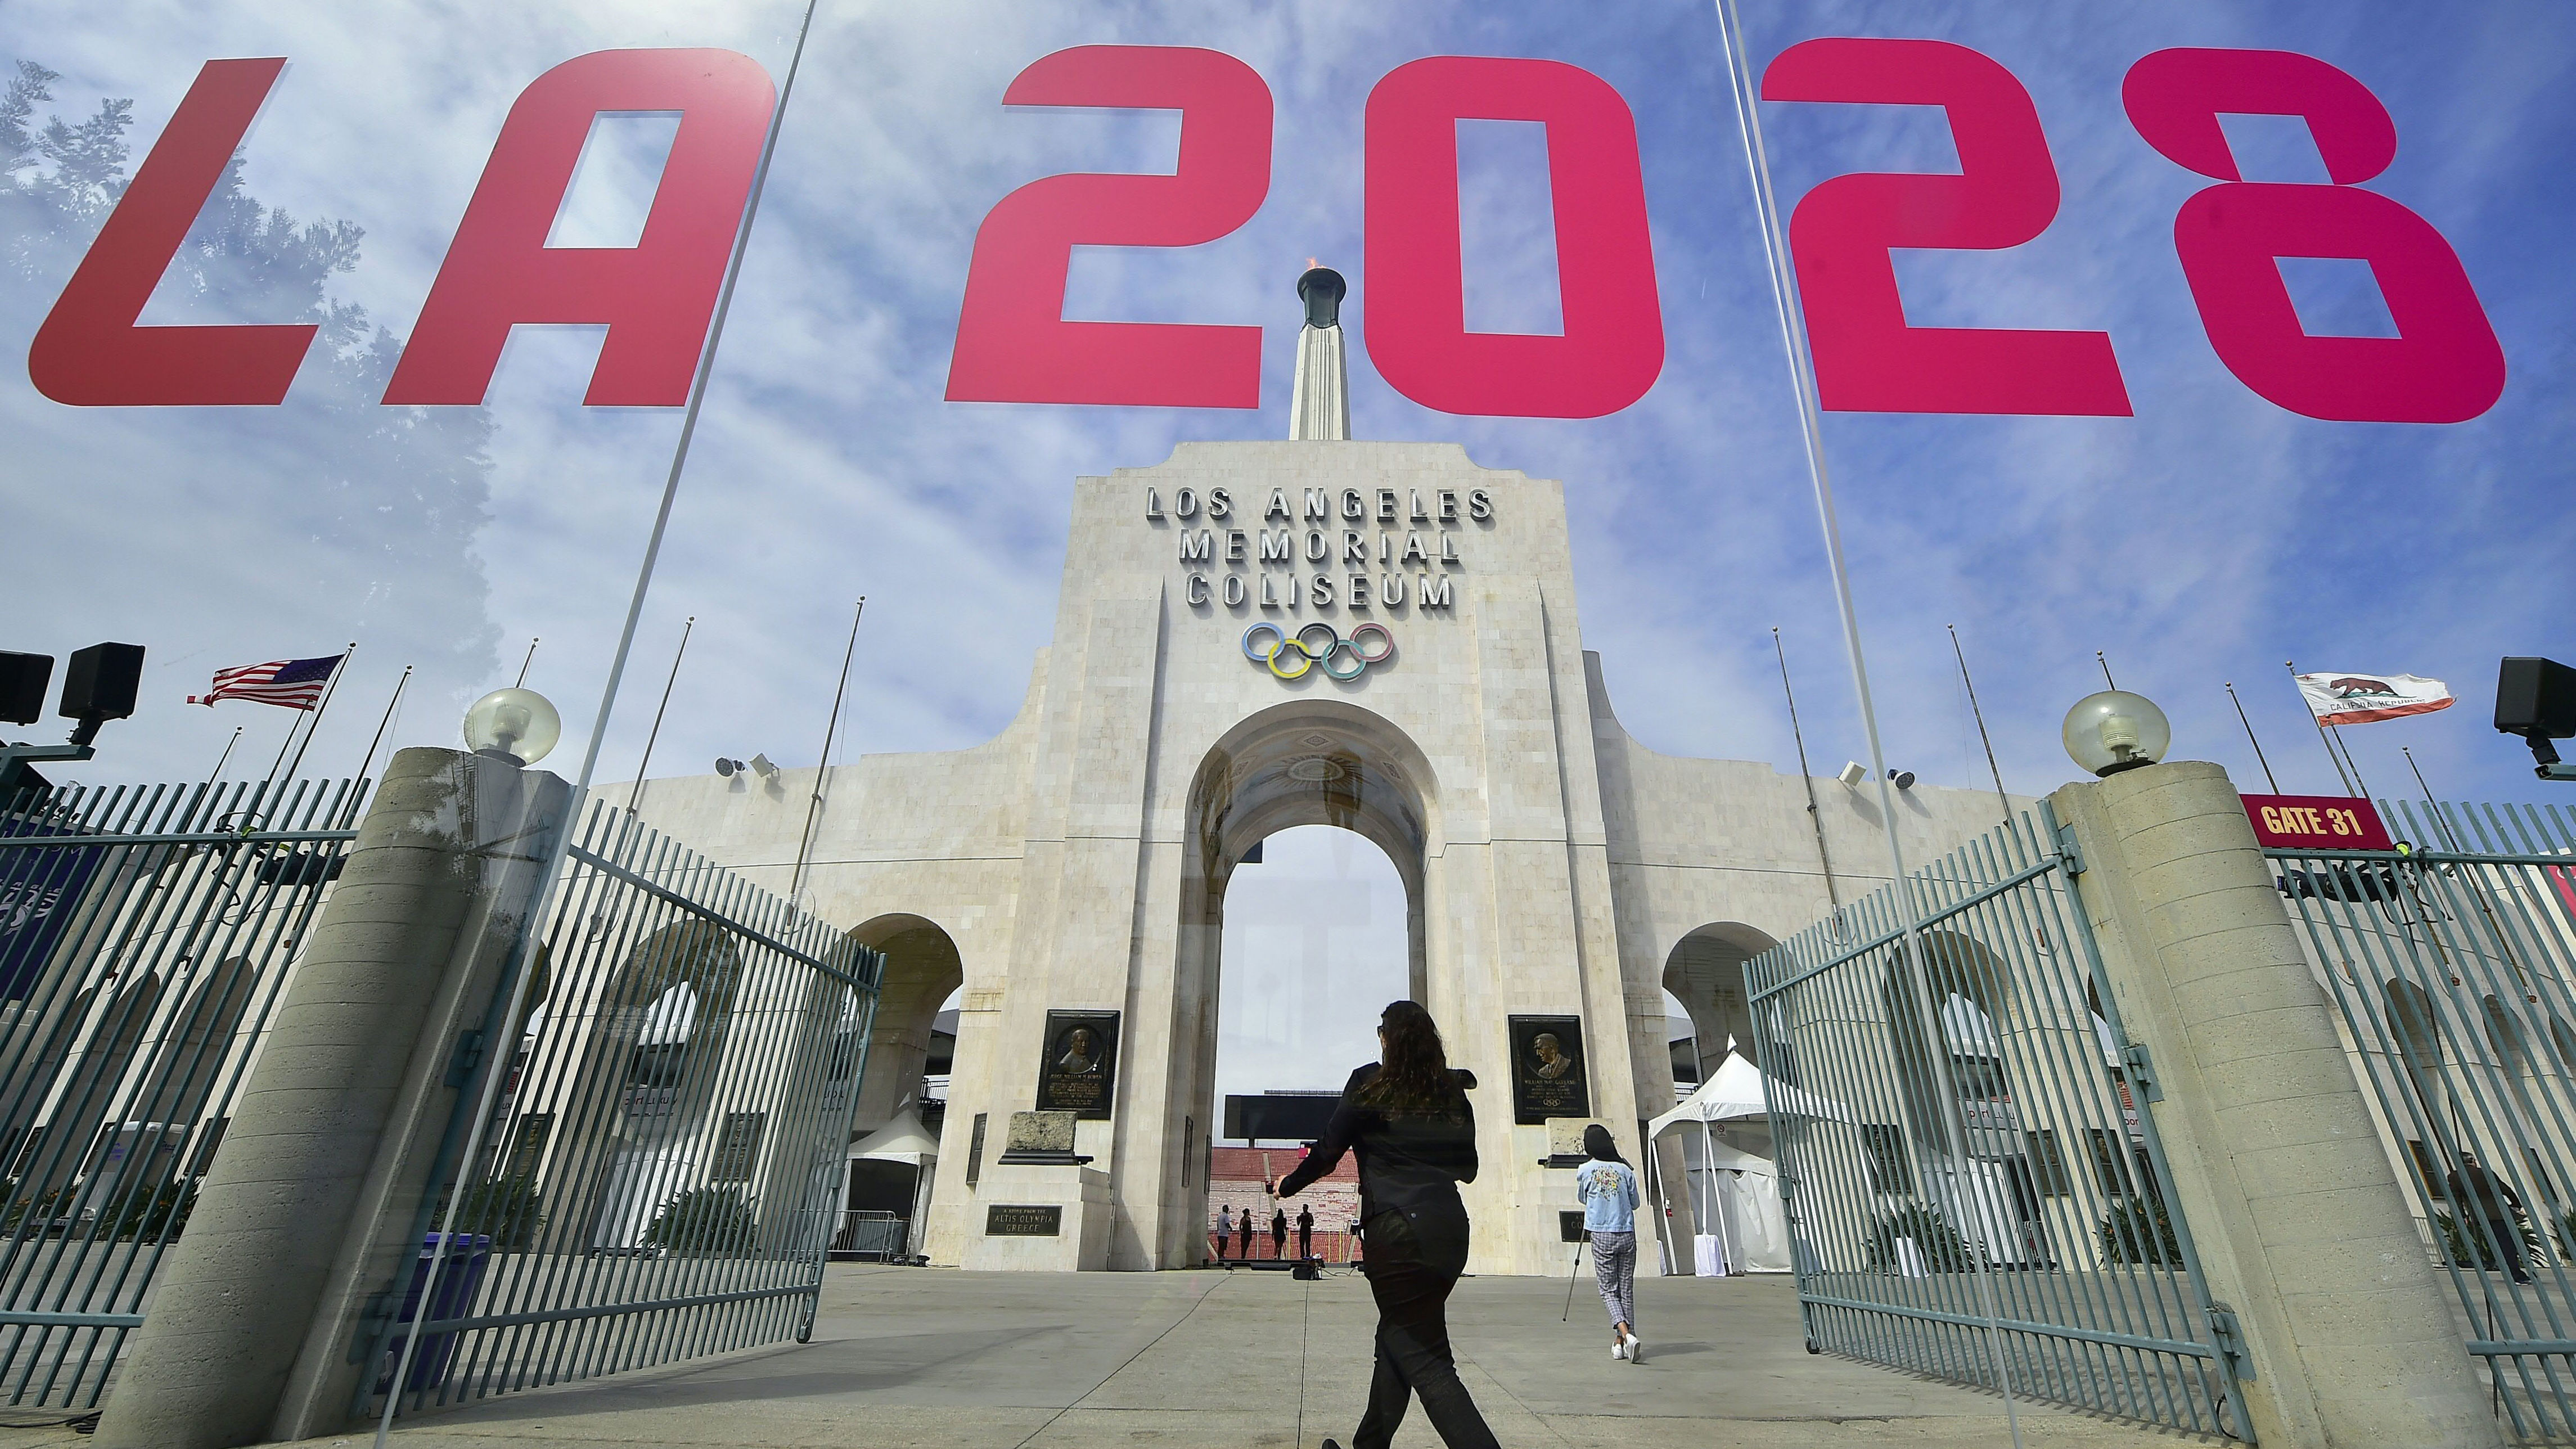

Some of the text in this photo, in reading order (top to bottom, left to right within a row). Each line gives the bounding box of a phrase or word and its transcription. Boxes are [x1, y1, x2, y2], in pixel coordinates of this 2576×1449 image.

[28, 38, 2506, 424] LA 2028
[1145, 487, 1492, 522] LOS ANGELES
[1179, 529, 1460, 564] MEMORIAL
[1186, 572, 1450, 609] COLISEUM
[2260, 806, 2363, 836] GATE 31
